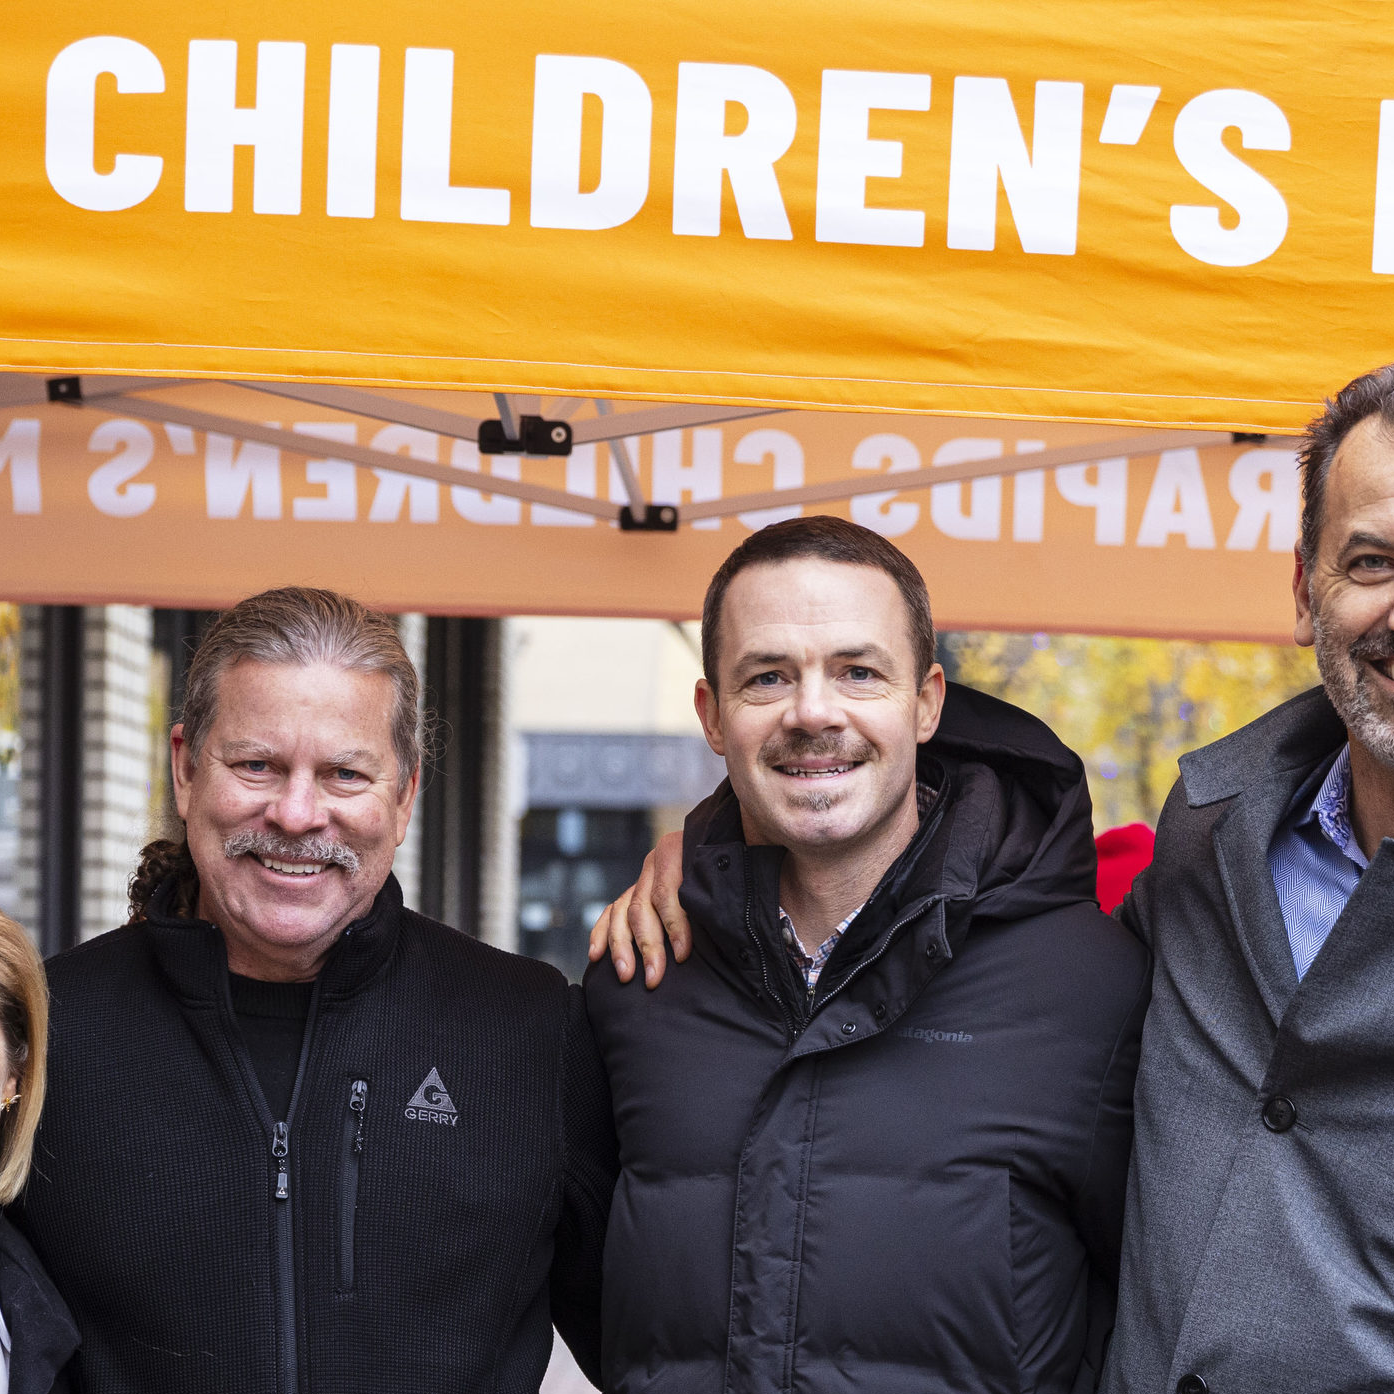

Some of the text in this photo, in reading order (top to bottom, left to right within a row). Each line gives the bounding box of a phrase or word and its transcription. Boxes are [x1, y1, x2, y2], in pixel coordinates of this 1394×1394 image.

[45, 36, 1292, 267] CHILDREN'S
[897, 1026, 974, 1043] tagonia
[404, 1108, 458, 1127] GERRY
